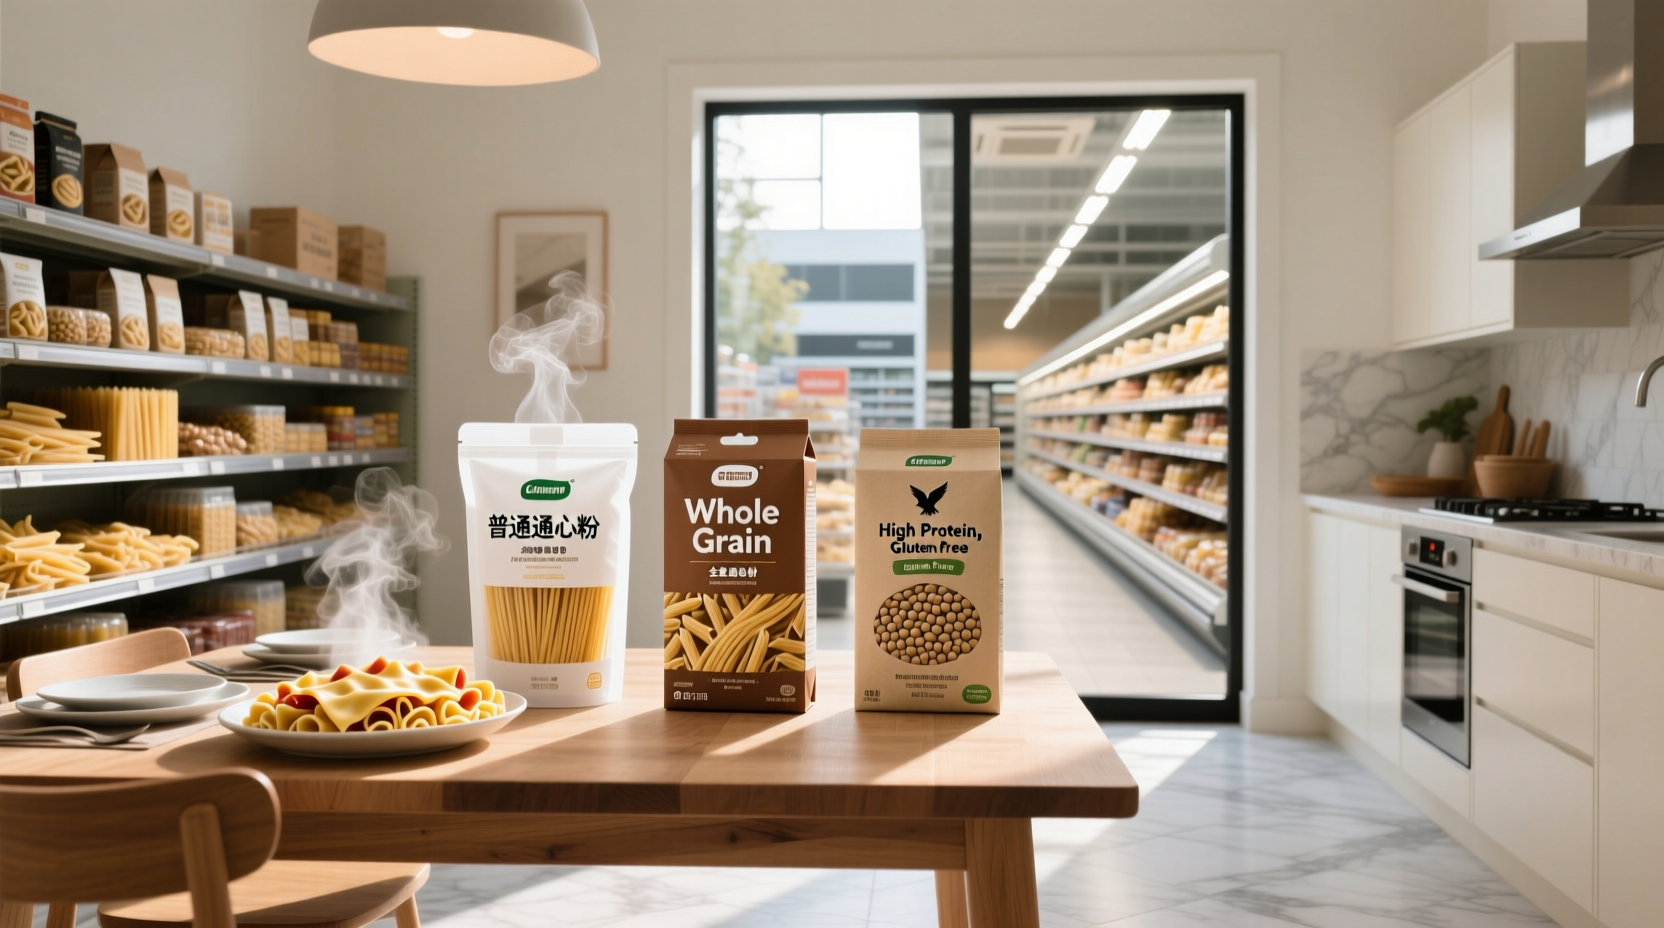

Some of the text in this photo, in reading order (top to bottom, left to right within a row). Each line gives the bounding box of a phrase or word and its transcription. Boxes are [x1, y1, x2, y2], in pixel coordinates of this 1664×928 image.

[684, 498, 780, 525] Whole
[488, 514, 600, 540] 普通通心粉
[879, 523, 983, 542] High Protein,
[692, 527, 772, 554] Grain
[940, 541, 969, 554] Free
